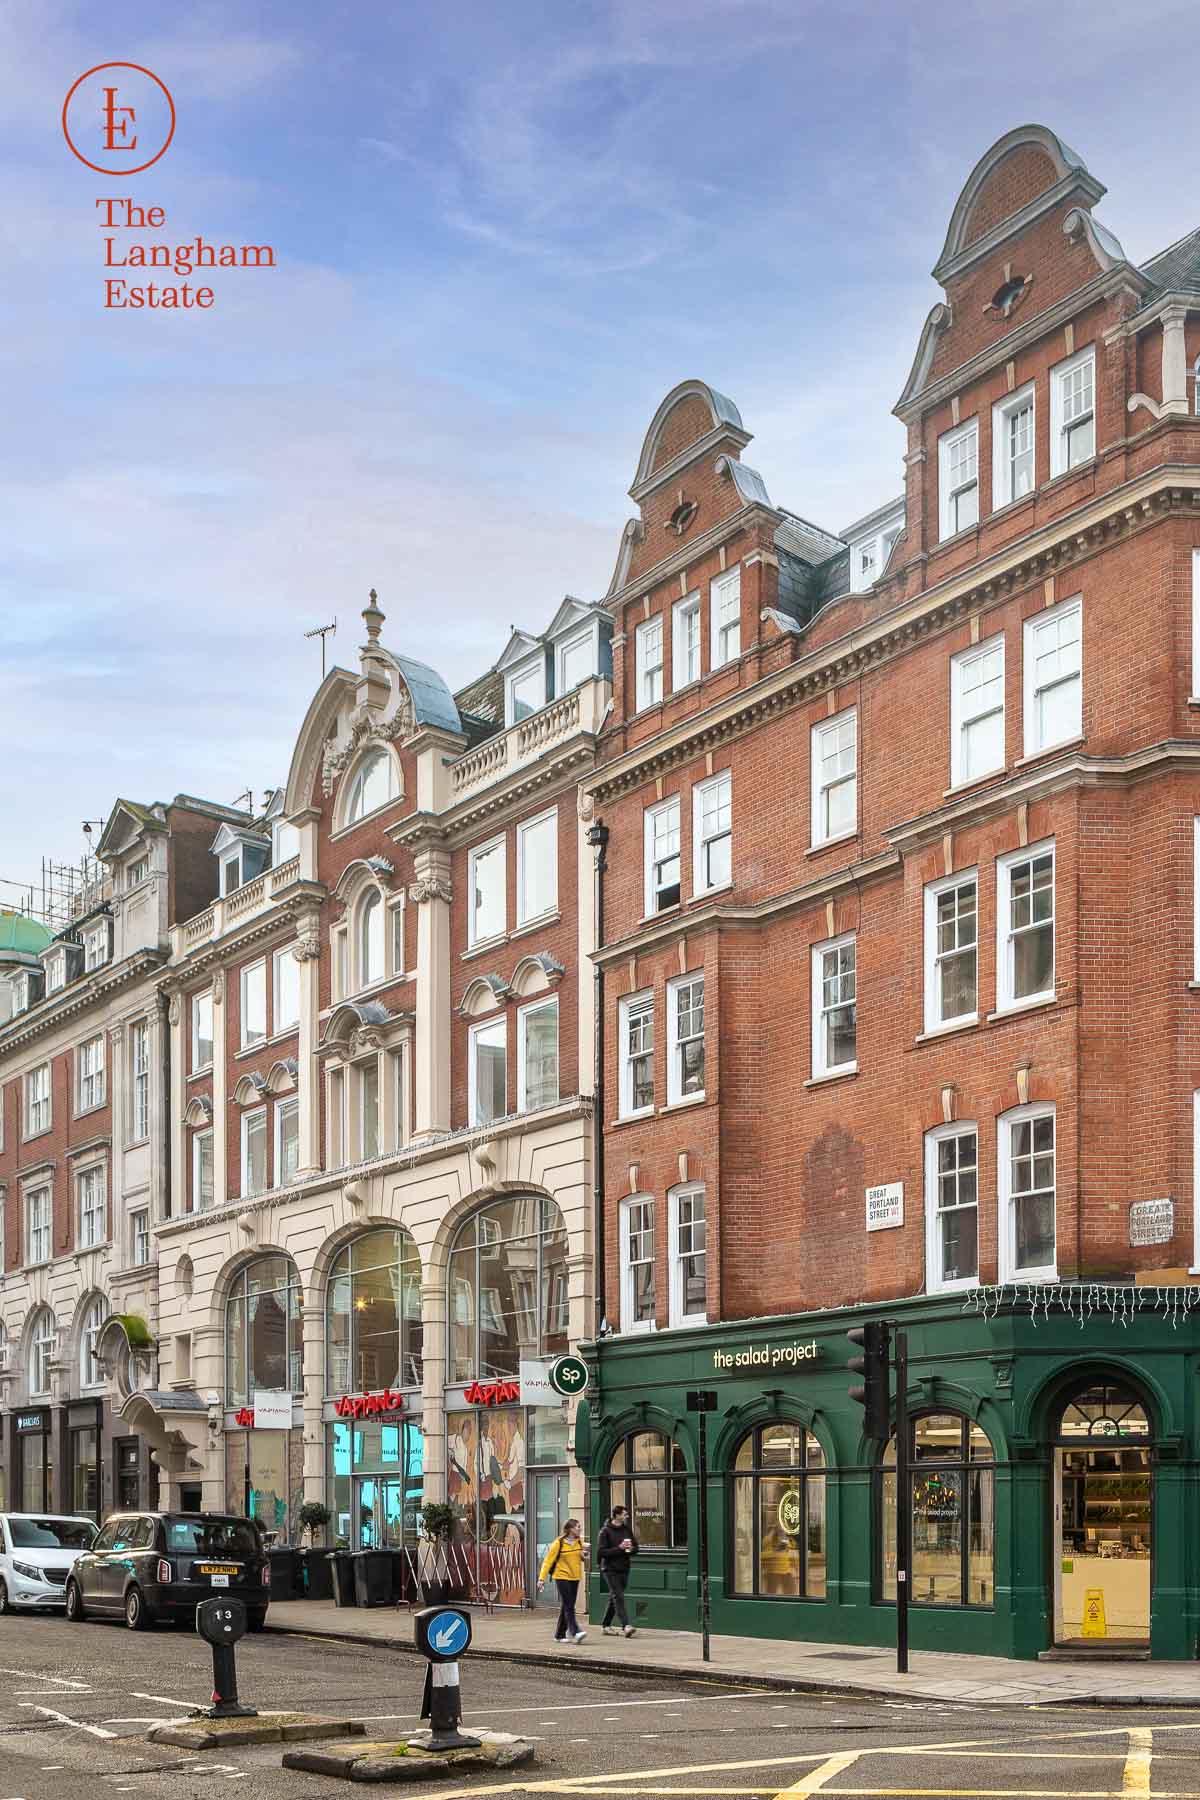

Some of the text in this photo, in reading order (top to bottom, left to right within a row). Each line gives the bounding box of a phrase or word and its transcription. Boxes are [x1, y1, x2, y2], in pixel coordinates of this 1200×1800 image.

[869, 1188, 887, 1200] GREAT
[869, 1196, 899, 1210] PORTLAND
[869, 1208, 889, 1220] STREET
[713, 1339, 817, 1368] the salad project
[333, 1387, 404, 1419] VAPIANO
[463, 1378, 520, 1408] VAPIAN
